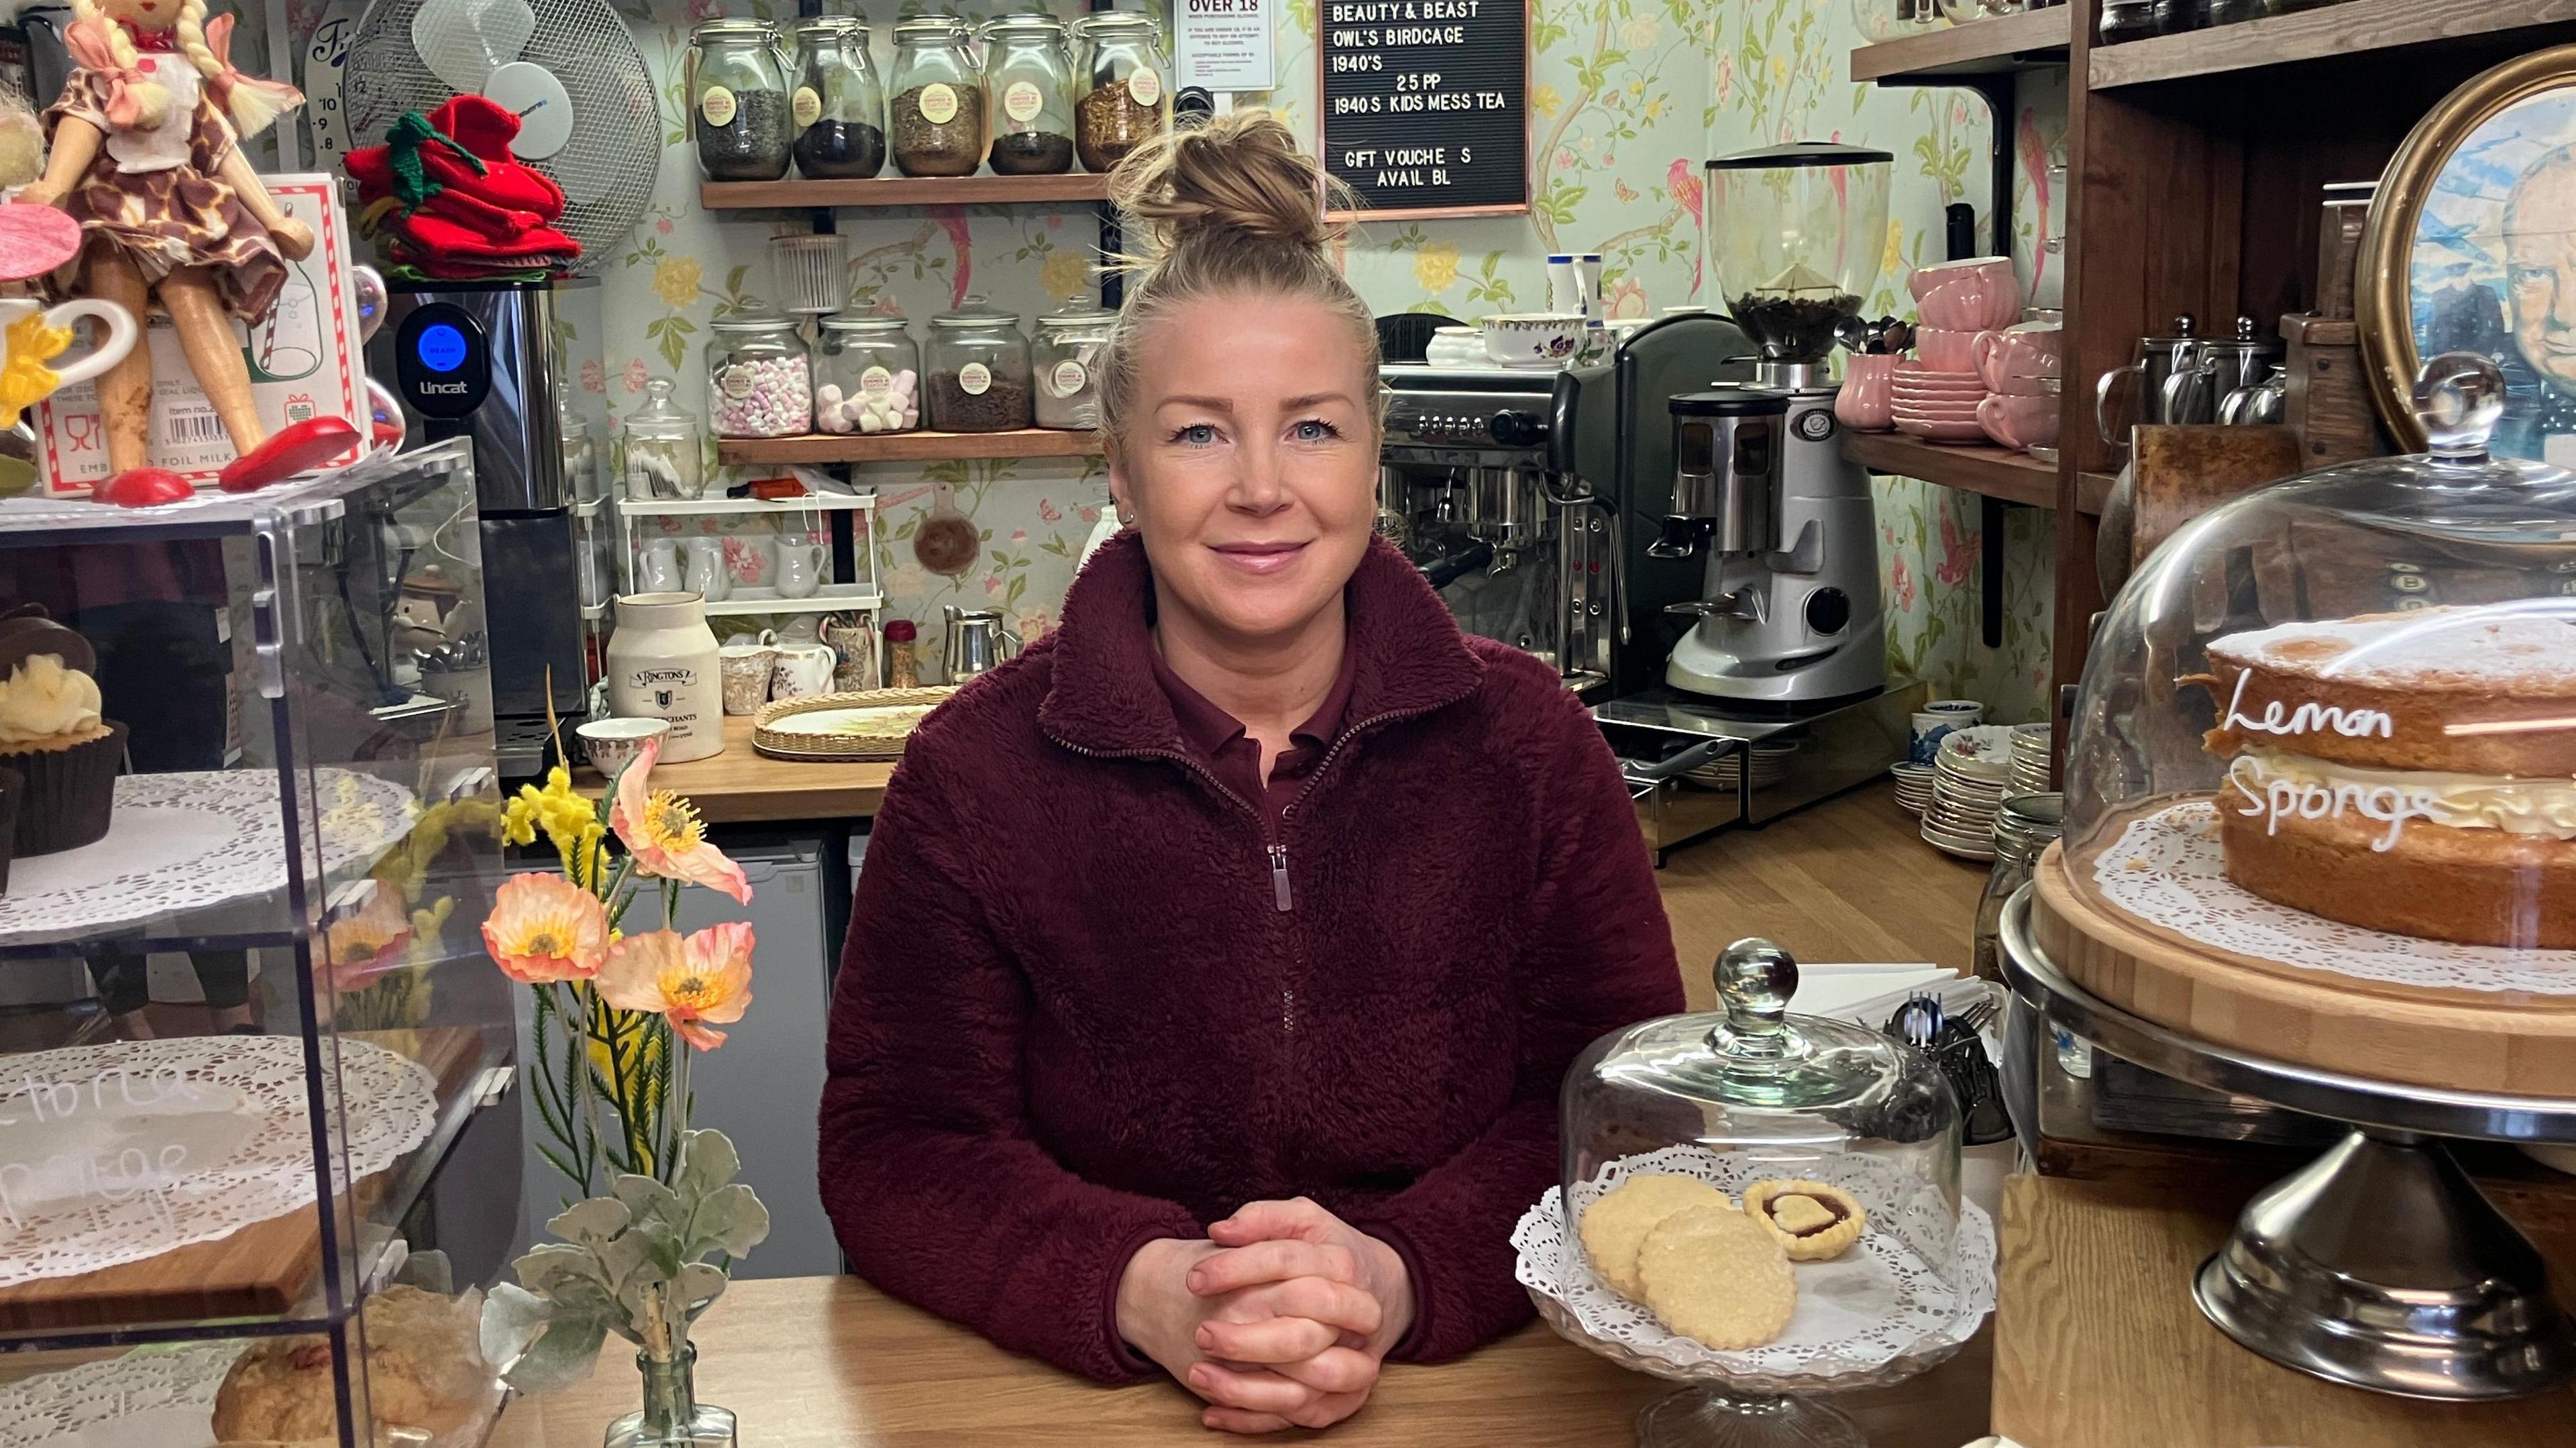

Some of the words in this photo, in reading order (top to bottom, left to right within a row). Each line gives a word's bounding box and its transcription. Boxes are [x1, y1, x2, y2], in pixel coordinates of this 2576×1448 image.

[1189, 0, 1232, 12] OVER
[1239, 0, 1258, 11] 18
[1333, 4, 1399, 21] BEAUTY
[1405, 3, 1417, 19] &
[1424, 1, 1479, 19] BEAST
[1333, 30, 1379, 47] OWL'S
[1386, 27, 1464, 45] BIRDCAGE
[1332, 55, 1383, 72] 1940'S
[1424, 74, 1441, 90] PP
[323, 98, 336, 111] 10
[1390, 95, 1424, 112] KIDS
[1428, 93, 1471, 111] MESS
[1477, 93, 1505, 109] TEA
[319, 118, 327, 130] 9
[325, 137, 333, 150] 8
[1377, 170, 1424, 186] AVAIL
[1432, 169, 1451, 185] BL
[420, 381, 468, 394] Lincat
[169, 407, 191, 415] Item
[162, 457, 193, 467] FOIL
[200, 453, 231, 463] MILK
[2223, 668, 2393, 738] Lemon
[2228, 755, 2451, 852] Sponge
